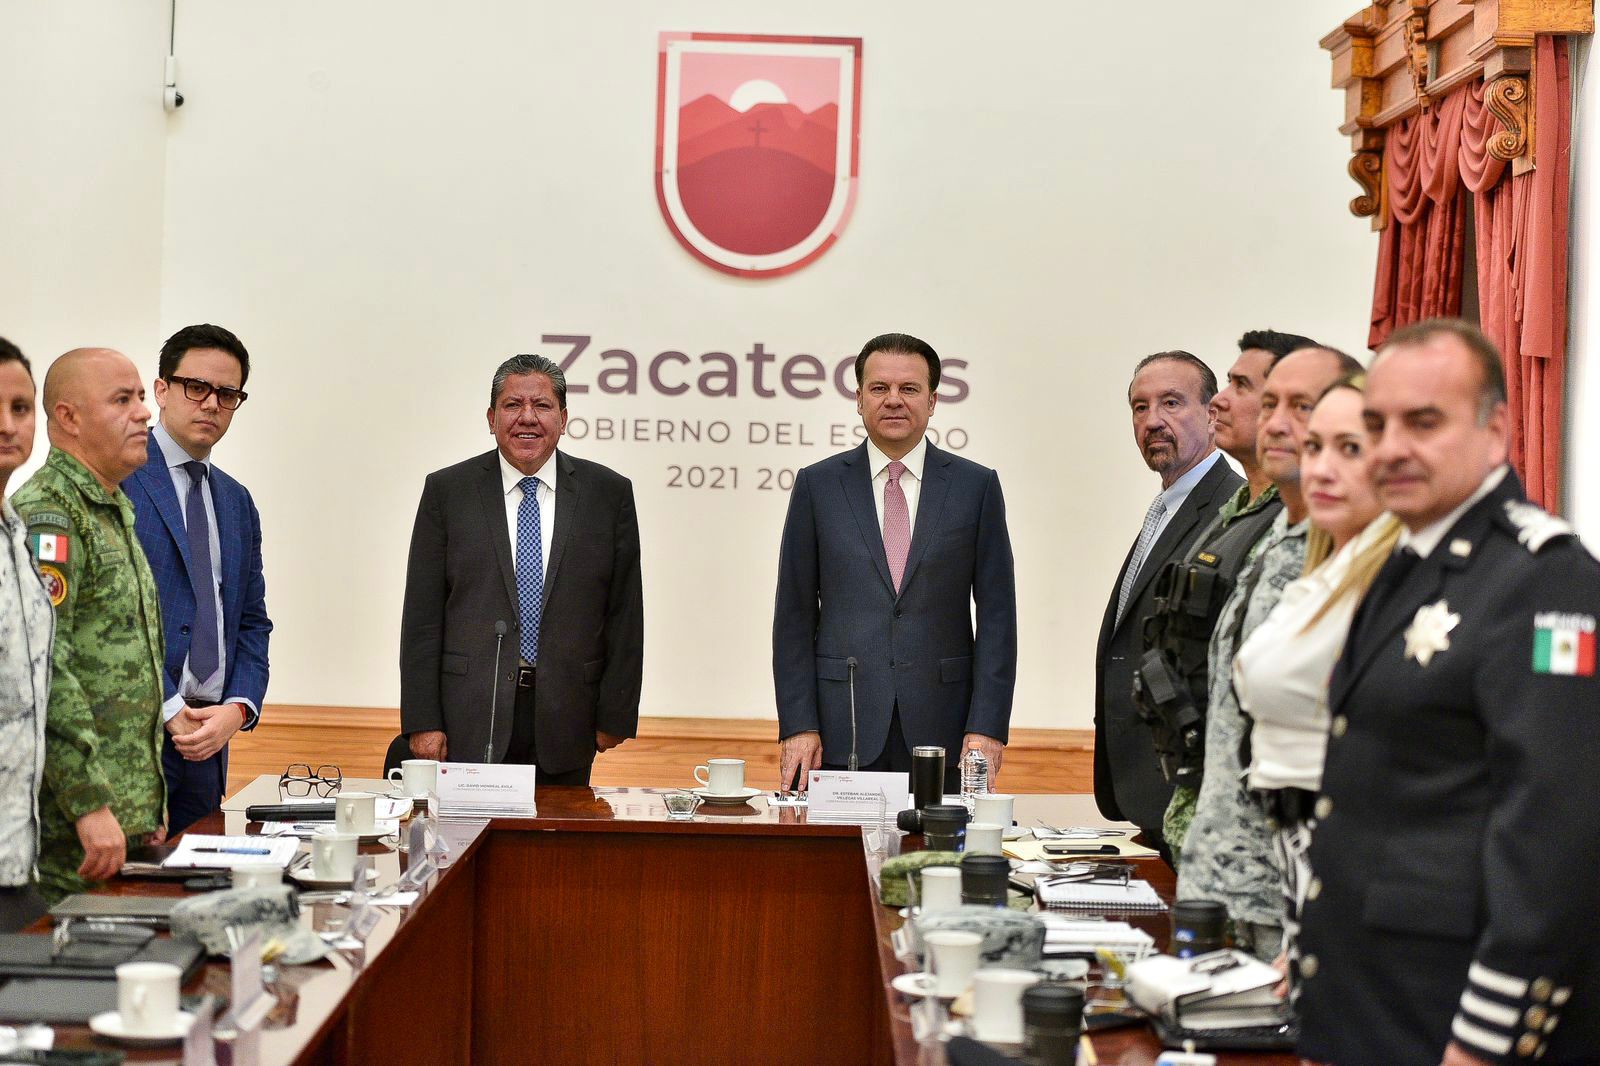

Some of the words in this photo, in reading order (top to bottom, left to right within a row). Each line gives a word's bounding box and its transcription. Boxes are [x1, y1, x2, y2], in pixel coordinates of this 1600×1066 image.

[541, 334, 970, 404] Zacatecs
[566, 418, 731, 444] OBIERNO
[749, 422, 814, 446] DEL
[830, 424, 969, 450] ESO
[666, 465, 738, 489] 2021
[757, 468, 796, 490] 20
